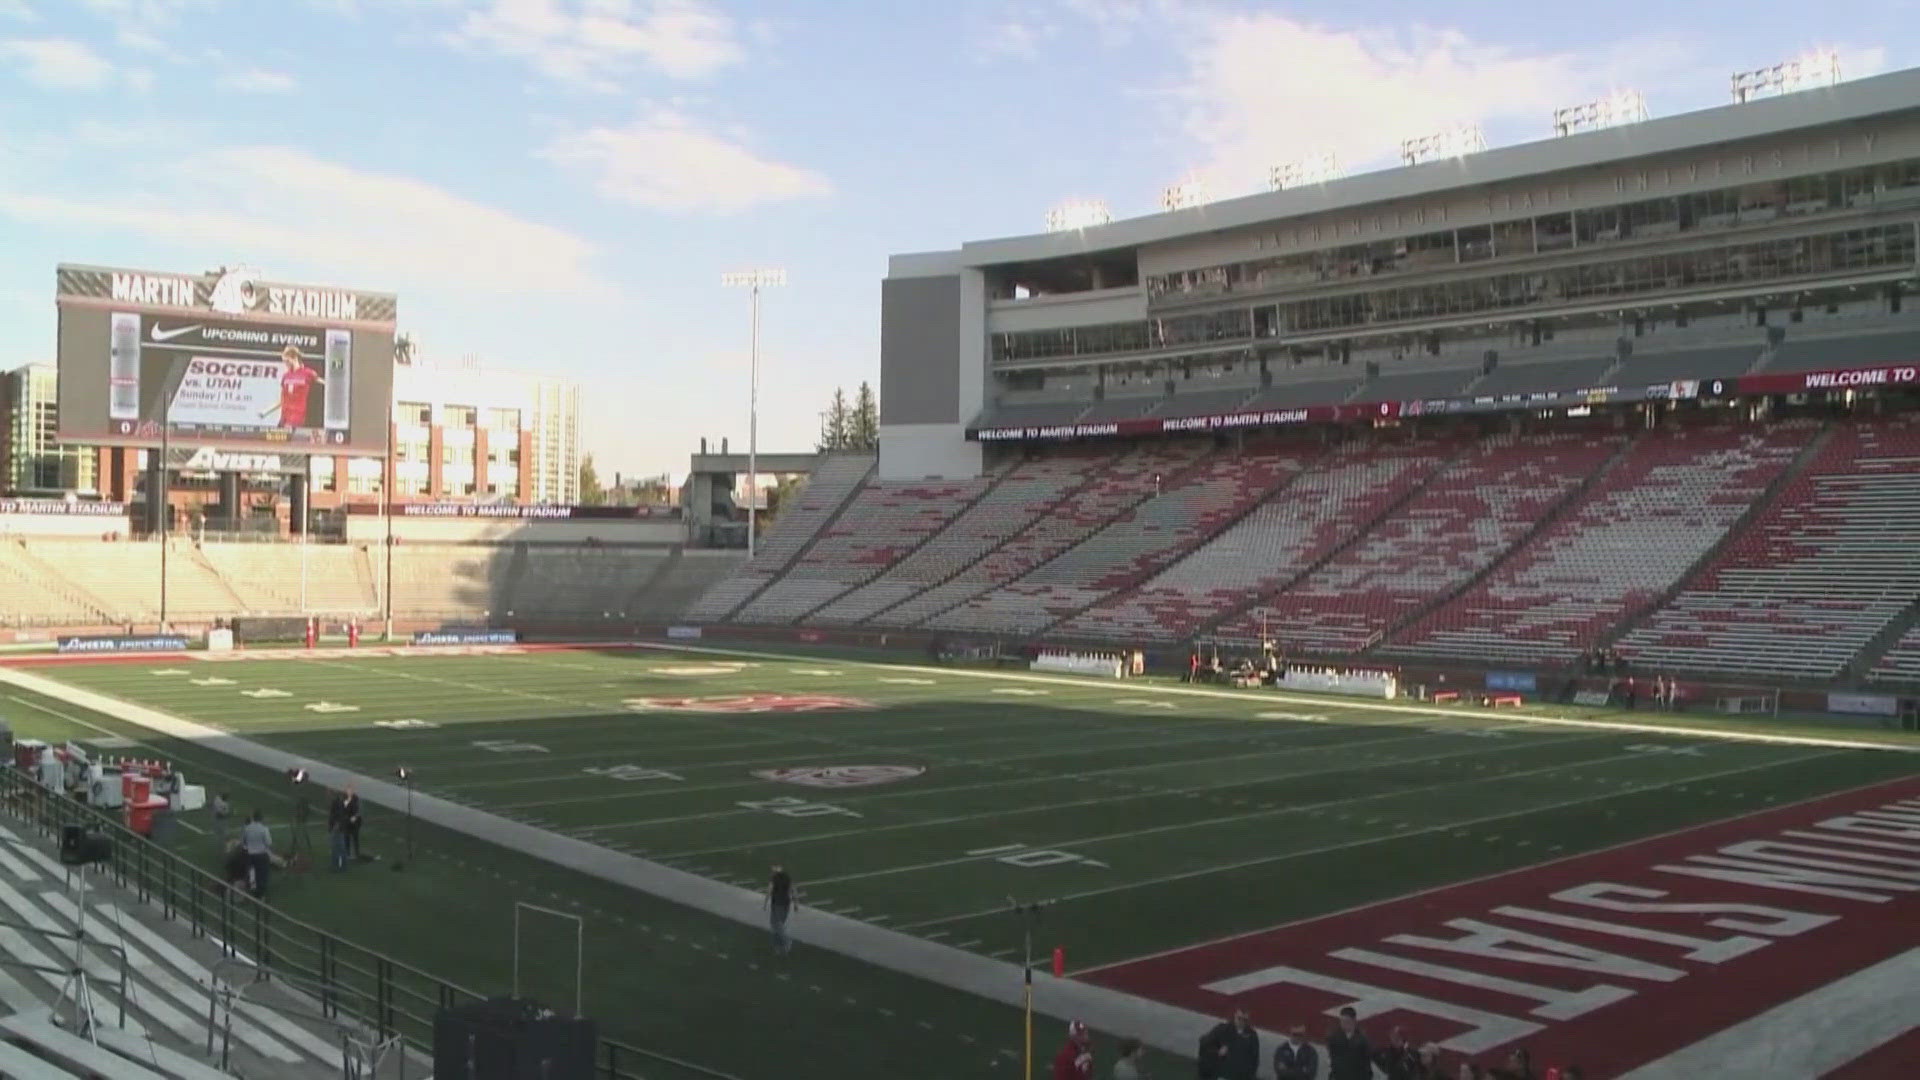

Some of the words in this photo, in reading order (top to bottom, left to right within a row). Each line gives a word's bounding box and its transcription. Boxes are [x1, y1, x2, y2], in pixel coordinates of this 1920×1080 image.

[112, 273, 194, 306] MARTIN
[269, 287, 357, 319] STADIUM
[202, 327, 268, 343] UPCOMING
[271, 333, 318, 347] EVENTS
[190, 360, 278, 378] SOCCER
[206, 378, 242, 390] UTAH
[1806, 369, 1887, 388] WELCOME
[1893, 367, 1915, 381] TO
[180, 389, 217, 401] Sunday
[1713, 380, 1723, 395] 0
[1381, 402, 1389, 416] 0
[121, 421, 131, 434] 0
[1163, 417, 1207, 432] WELCOME
[1210, 416, 1221, 428] TO
[1223, 412, 1260, 426] MARTIN
[1262, 408, 1308, 423] STADIUM
[335, 431, 344, 444] 0
[978, 427, 1023, 441] WELCOME
[1026, 427, 1038, 439] TO
[1040, 425, 1075, 438] MARTIN
[1077, 422, 1118, 436] STADIUM
[0, 501, 15, 513] TO
[20, 501, 66, 514] MARTIN
[69, 502, 124, 516] STADIUM
[405, 505, 458, 516] WELCOME
[461, 506, 476, 516] TO
[479, 506, 520, 517] MARTIN
[522, 507, 571, 518] STADIUM
